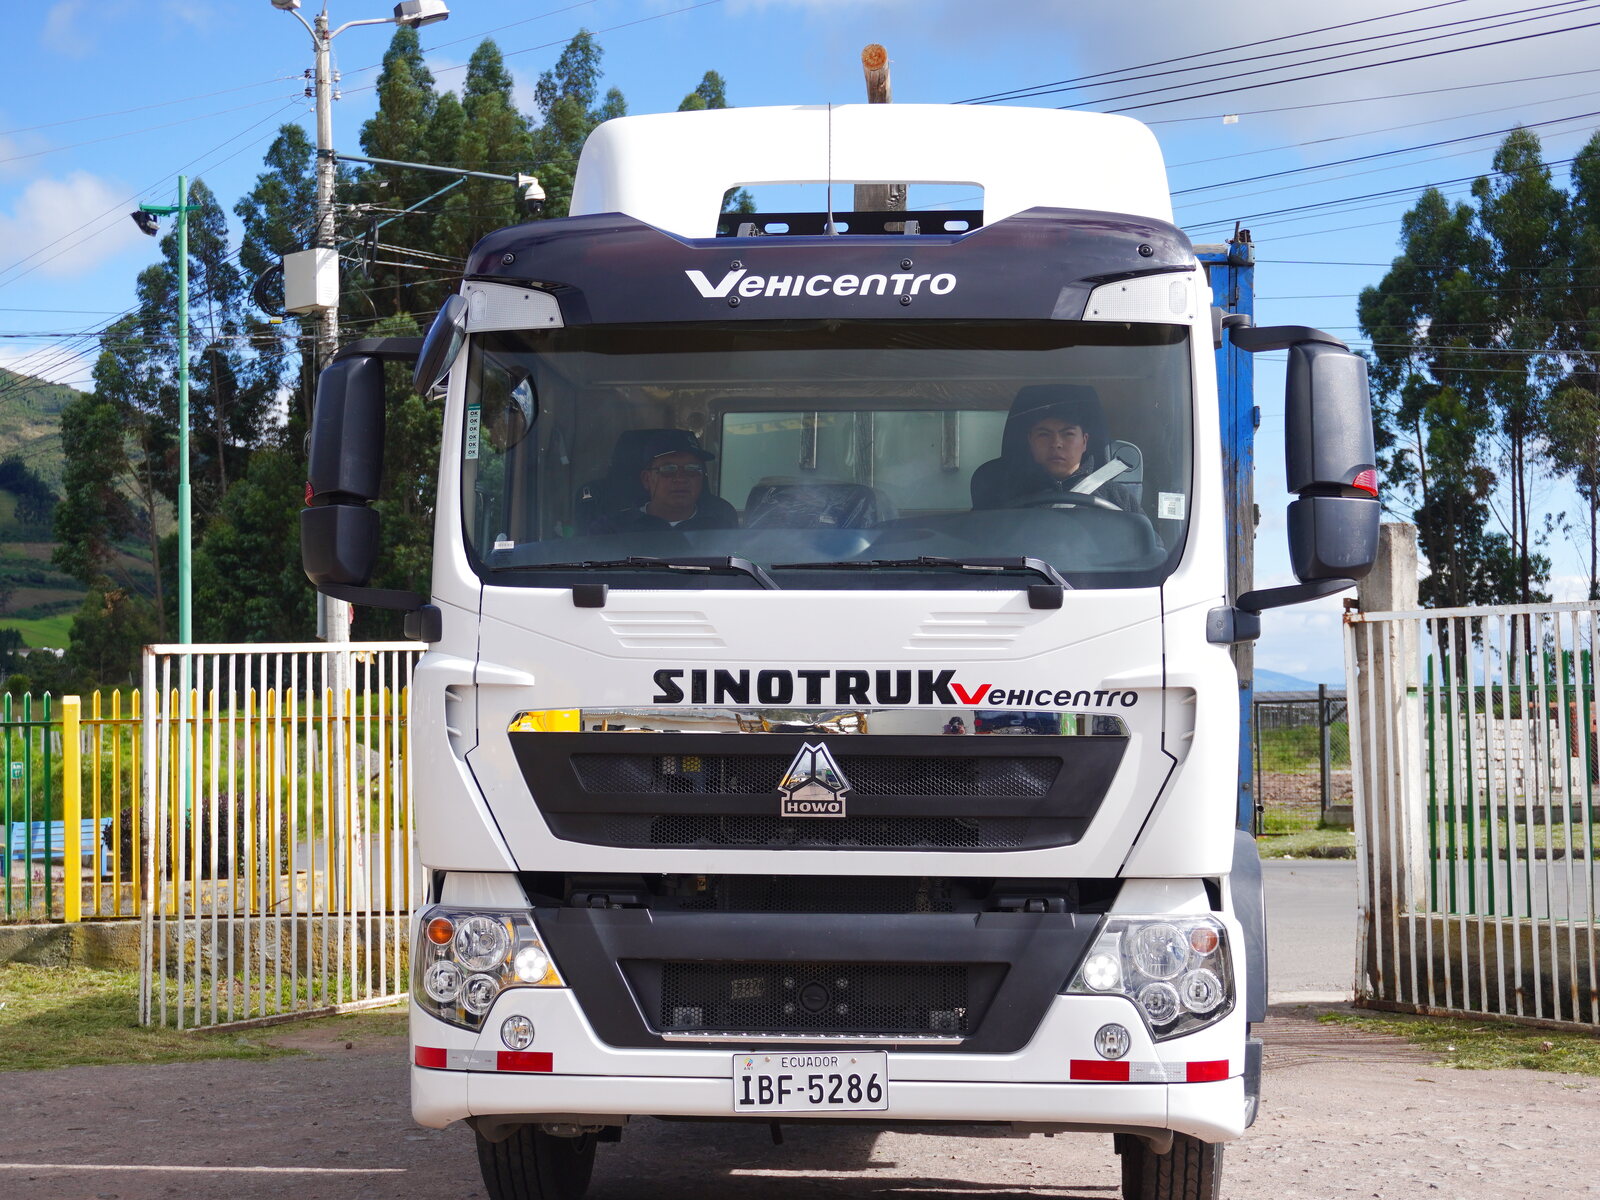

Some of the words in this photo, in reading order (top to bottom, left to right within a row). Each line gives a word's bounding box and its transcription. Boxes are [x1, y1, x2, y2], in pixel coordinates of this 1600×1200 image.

[653, 669, 957, 705] SINOTRUK
[787, 802, 840, 812] HOWO
[781, 1056, 838, 1067] ECUADOR
[739, 1073, 882, 1105] IBF-5286
